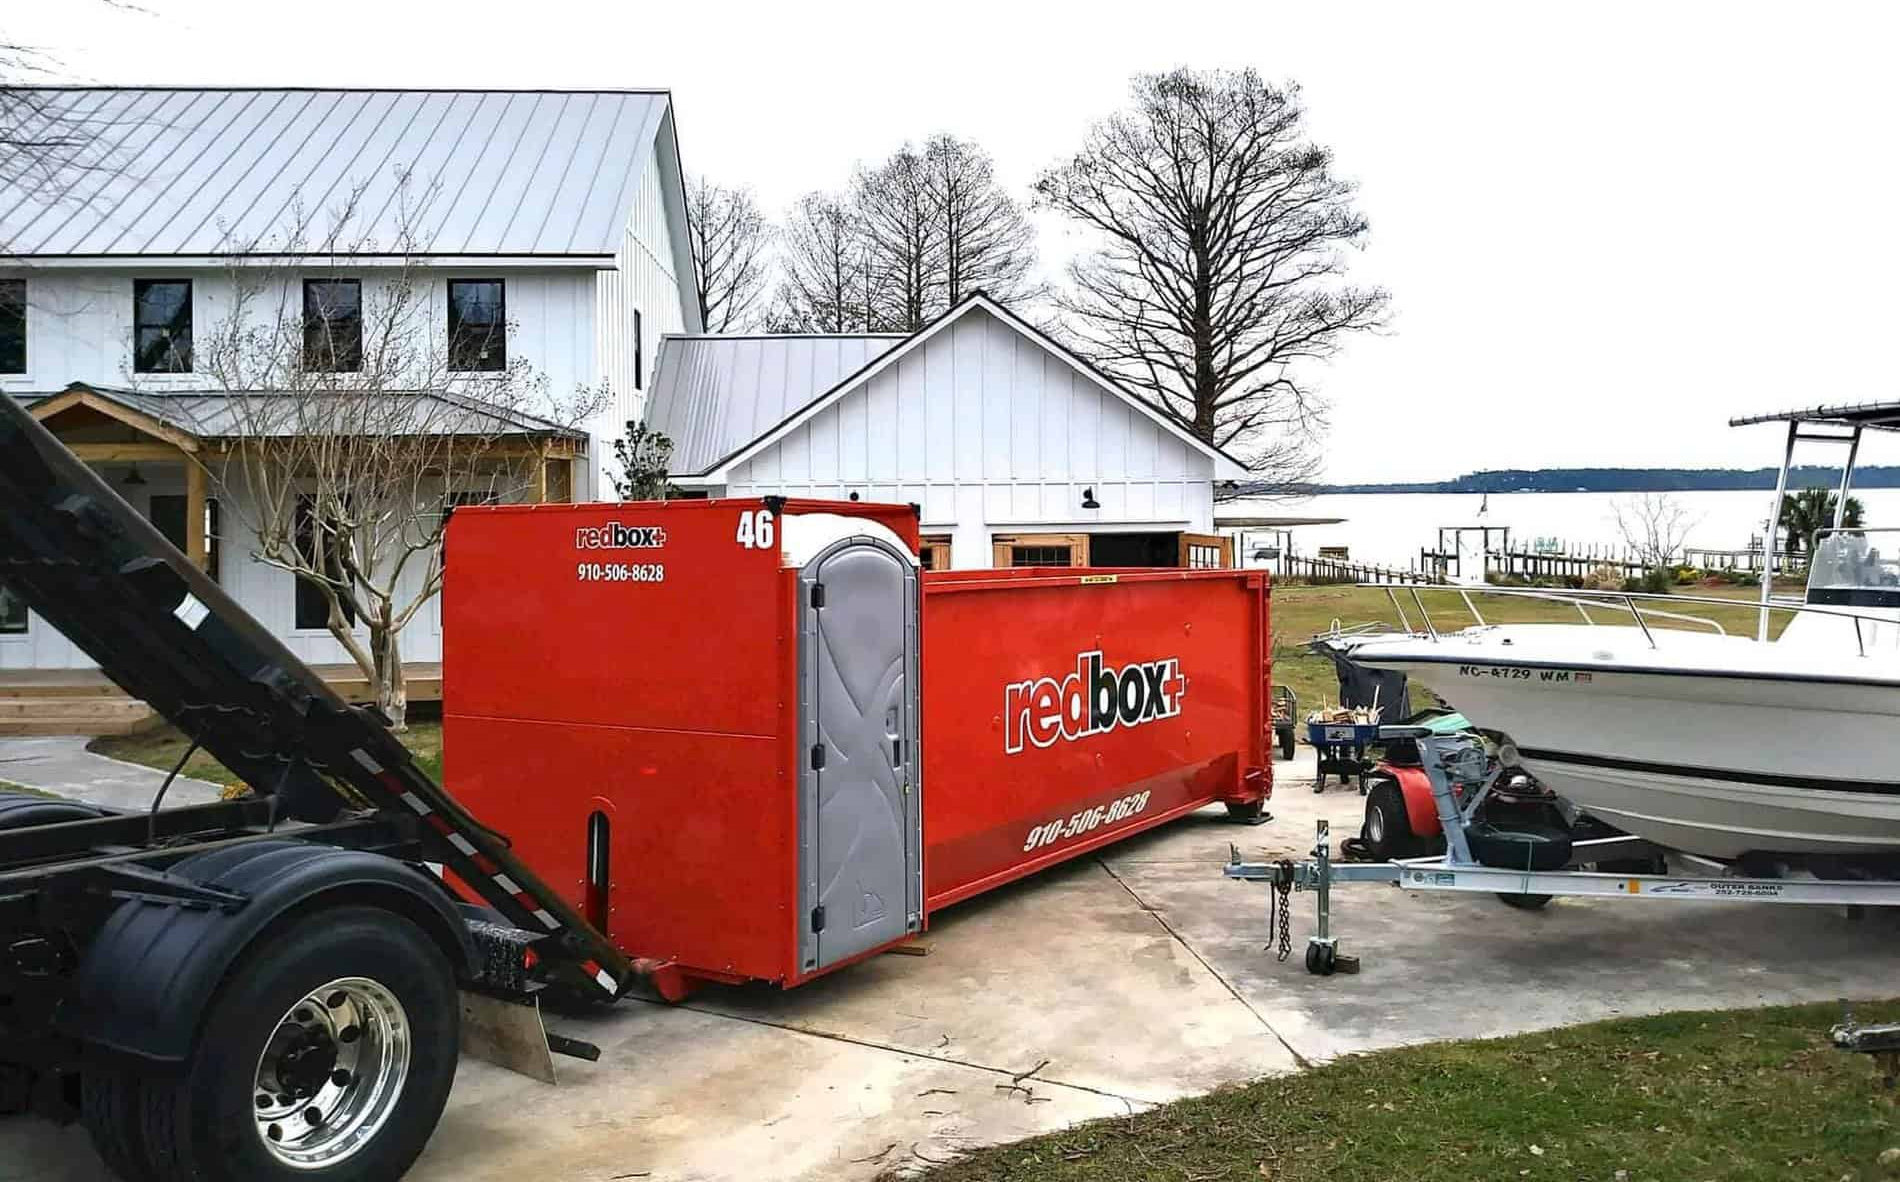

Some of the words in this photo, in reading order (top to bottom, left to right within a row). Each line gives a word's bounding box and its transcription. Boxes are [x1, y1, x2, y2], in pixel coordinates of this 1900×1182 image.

[736, 510, 774, 549] 46
[577, 563, 664, 582] 910-506-8628
[1459, 665, 1531, 680] NC-4729
[1540, 671, 1569, 682] WM
[1023, 790, 1151, 852] 910-506-8628
